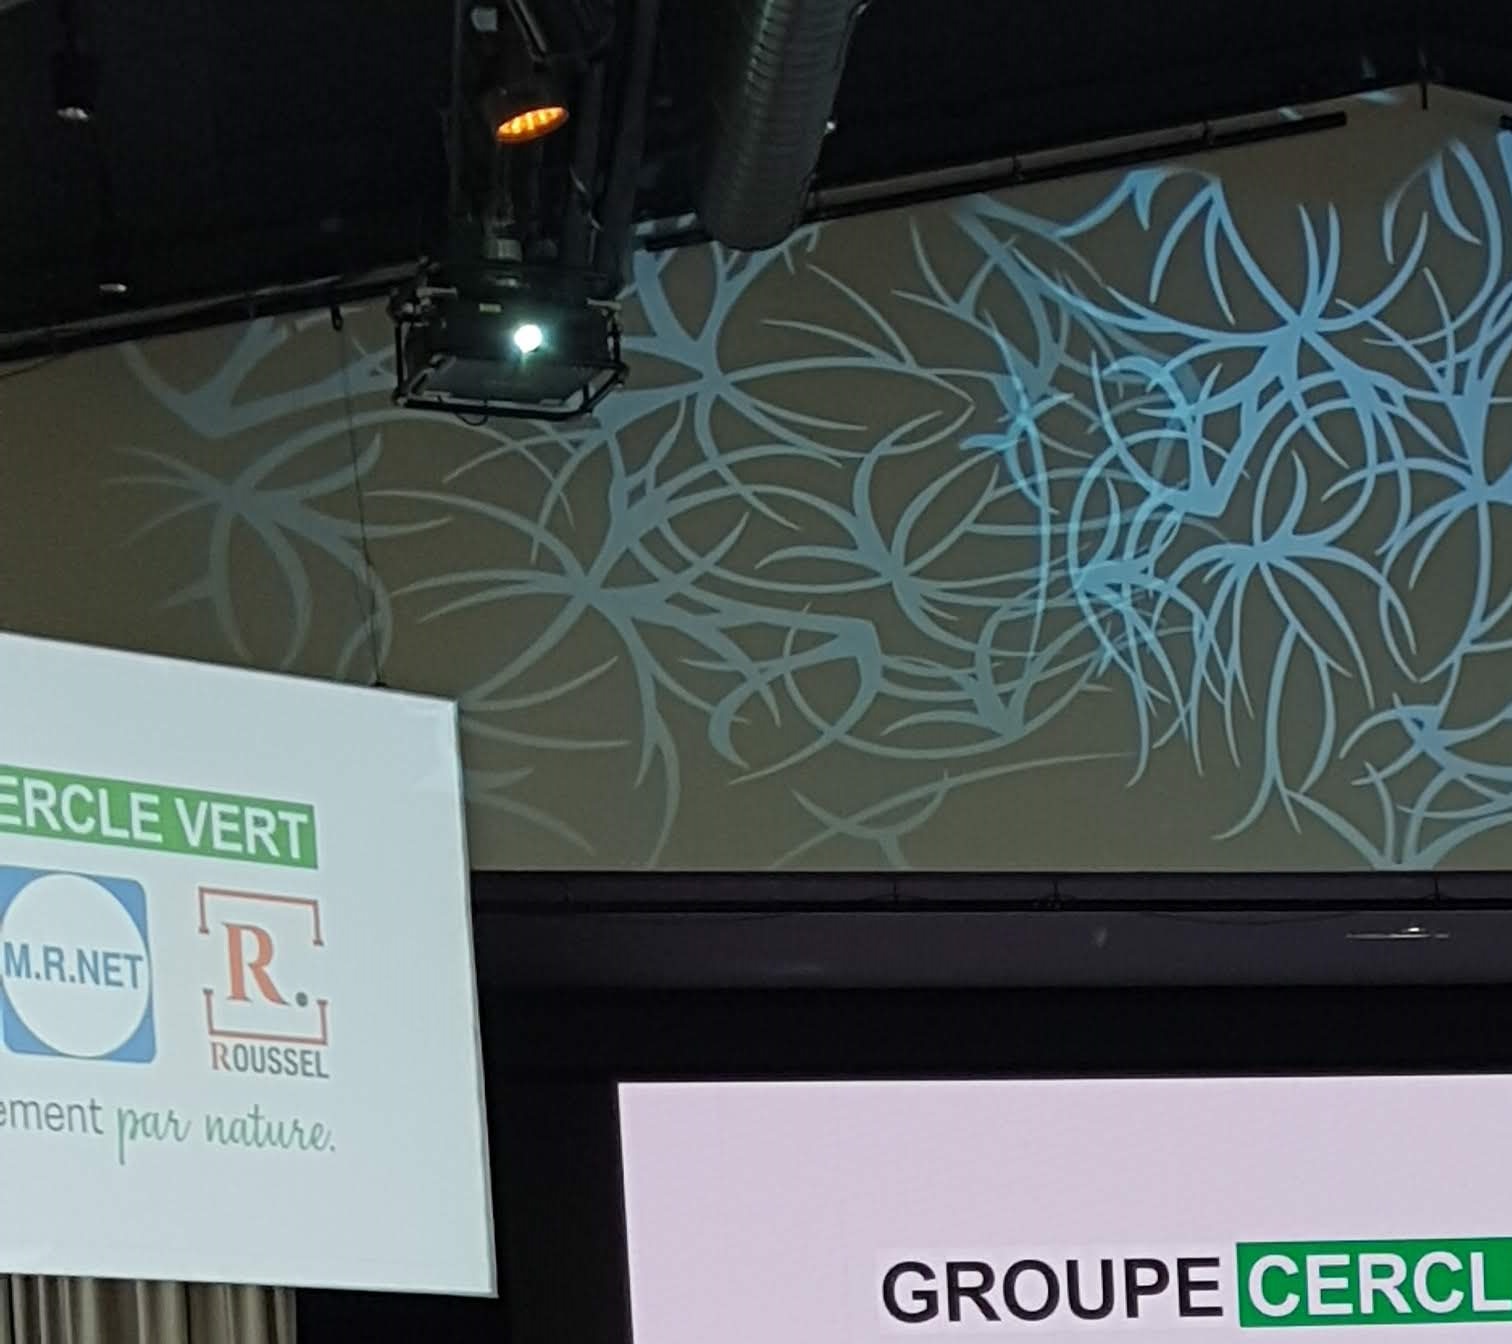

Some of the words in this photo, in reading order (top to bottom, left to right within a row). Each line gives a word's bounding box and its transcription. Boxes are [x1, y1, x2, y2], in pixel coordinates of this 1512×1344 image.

[174, 796, 310, 859] VERT
[4, 941, 144, 990] M.R.NET
[210, 1041, 330, 1079] ROUSSEL
[116, 1107, 191, 1166] par
[205, 1105, 337, 1153] nature.
[881, 1257, 1224, 1323] GROUPE
